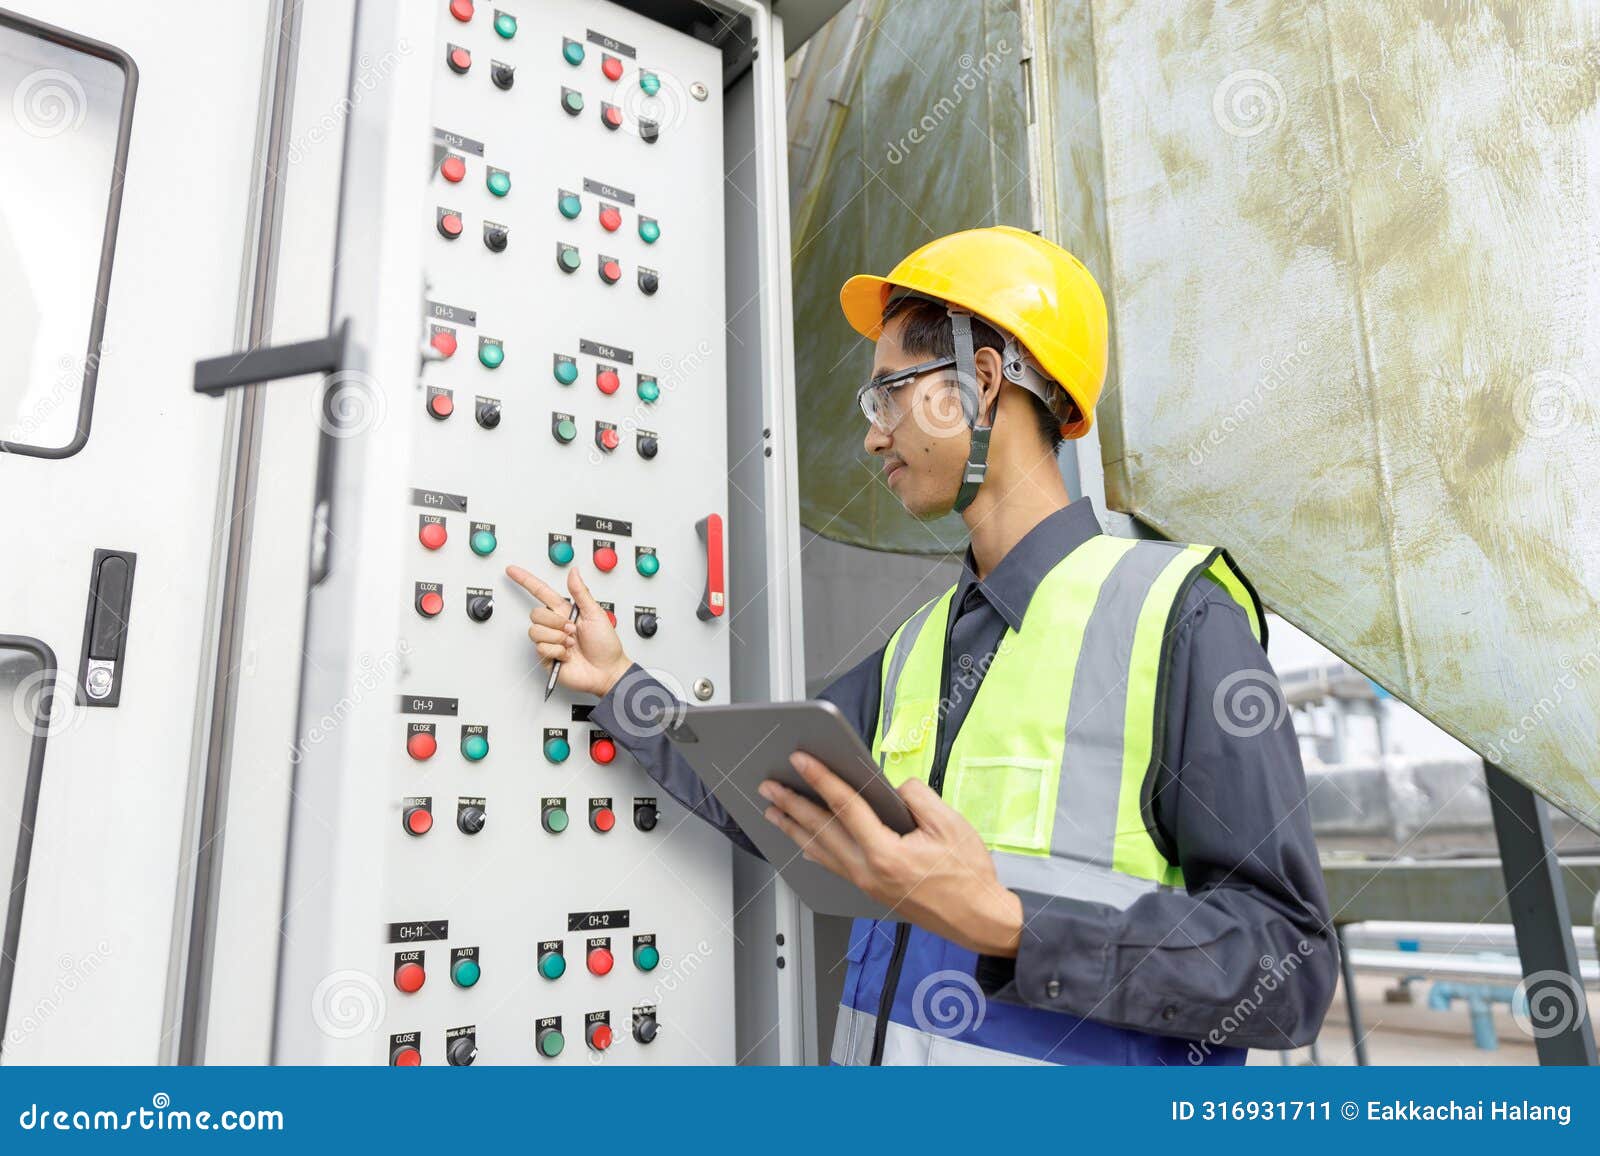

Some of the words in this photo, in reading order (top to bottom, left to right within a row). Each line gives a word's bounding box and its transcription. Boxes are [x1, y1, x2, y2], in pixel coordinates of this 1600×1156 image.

[424, 493, 444, 505] CH-7
[595, 519, 613, 531] CH-8
[420, 583, 438, 591] CLOSE
[412, 699, 434, 711] CH-9
[412, 724, 431, 732] CLOSE
[467, 726, 482, 734] AUTO
[588, 914, 610, 926] CH-12
[400, 926, 424, 938] CH-11
[590, 938, 607, 947] CLOSE
[637, 935, 652, 943] AUTO
[543, 942, 559, 950] OPEN
[400, 951, 420, 961] CLOSE
[457, 948, 474, 957] AUTO
[589, 1012, 606, 1021] CLOSE
[541, 1018, 556, 1027] OPEN
[395, 1034, 416, 1043] CLOSE
